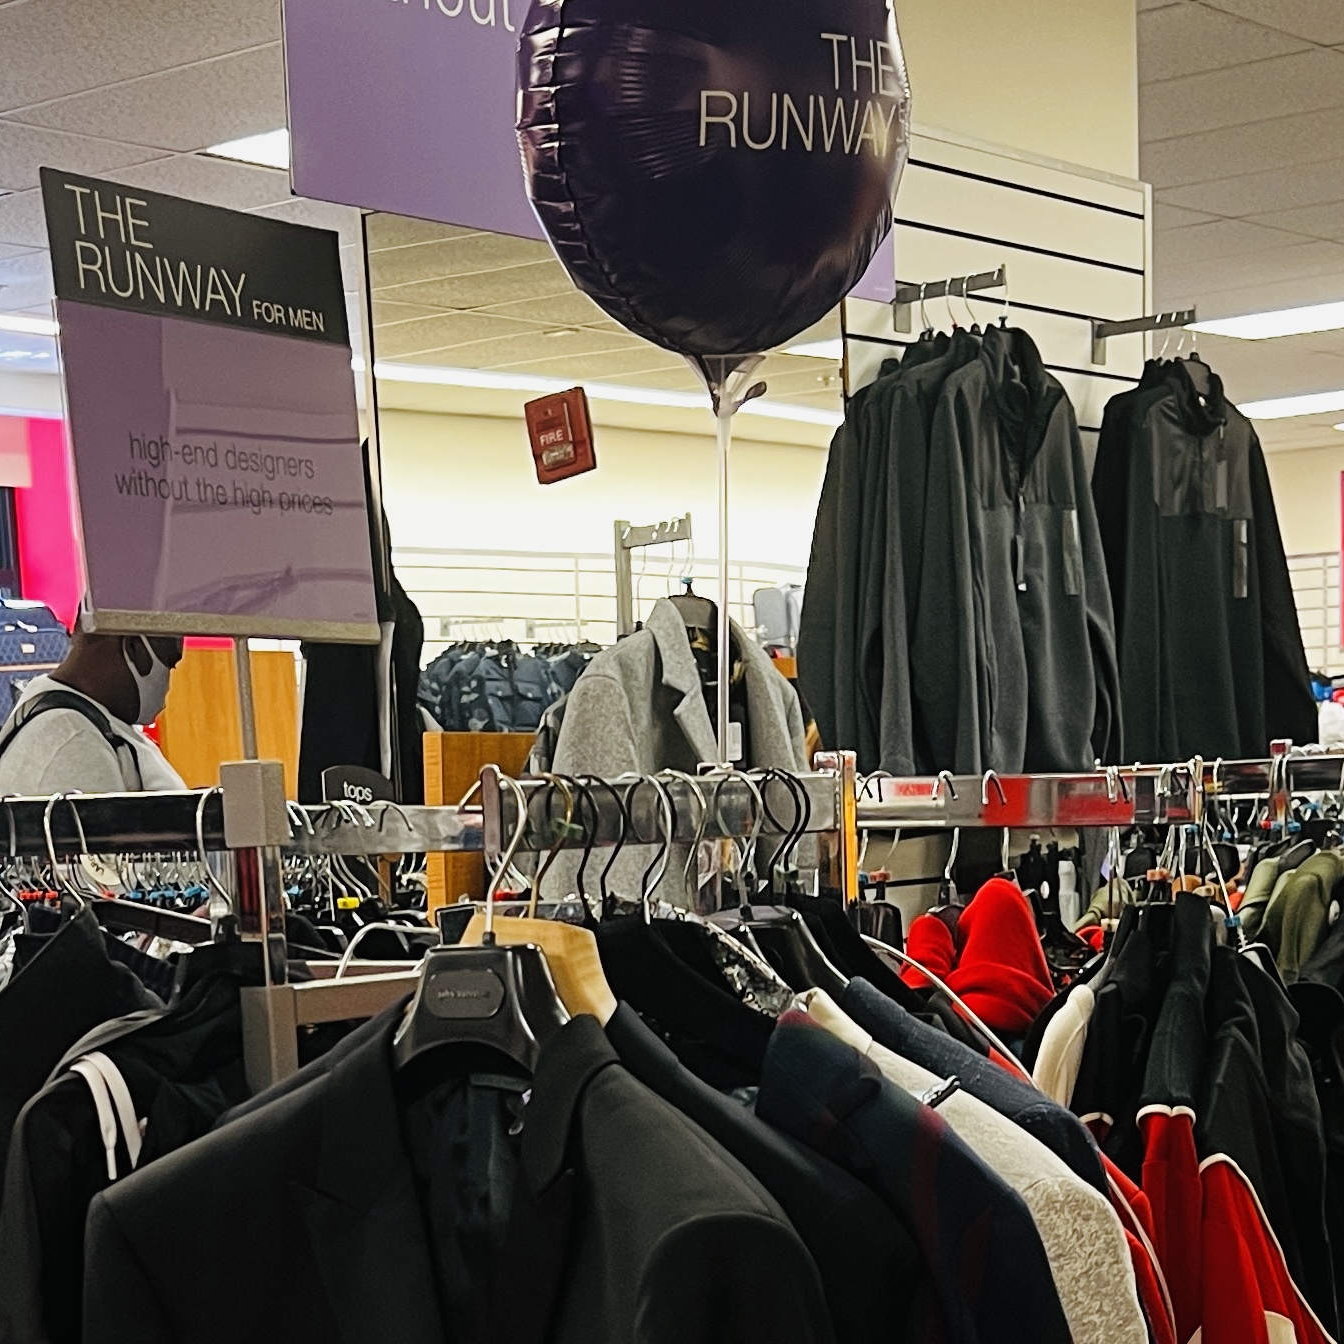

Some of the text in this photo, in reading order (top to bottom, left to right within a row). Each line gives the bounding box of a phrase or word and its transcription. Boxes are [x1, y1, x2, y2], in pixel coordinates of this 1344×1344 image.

[820, 32, 897, 97] THE
[698, 90, 897, 157] RUNWAY
[63, 183, 154, 249] THE
[75, 240, 325, 333] RUNWAY FOR MEN
[128, 431, 315, 481] high-end designers
[539, 429, 564, 447] FIRE
[114, 468, 334, 518] without the high prices
[343, 781, 373, 803] tops
